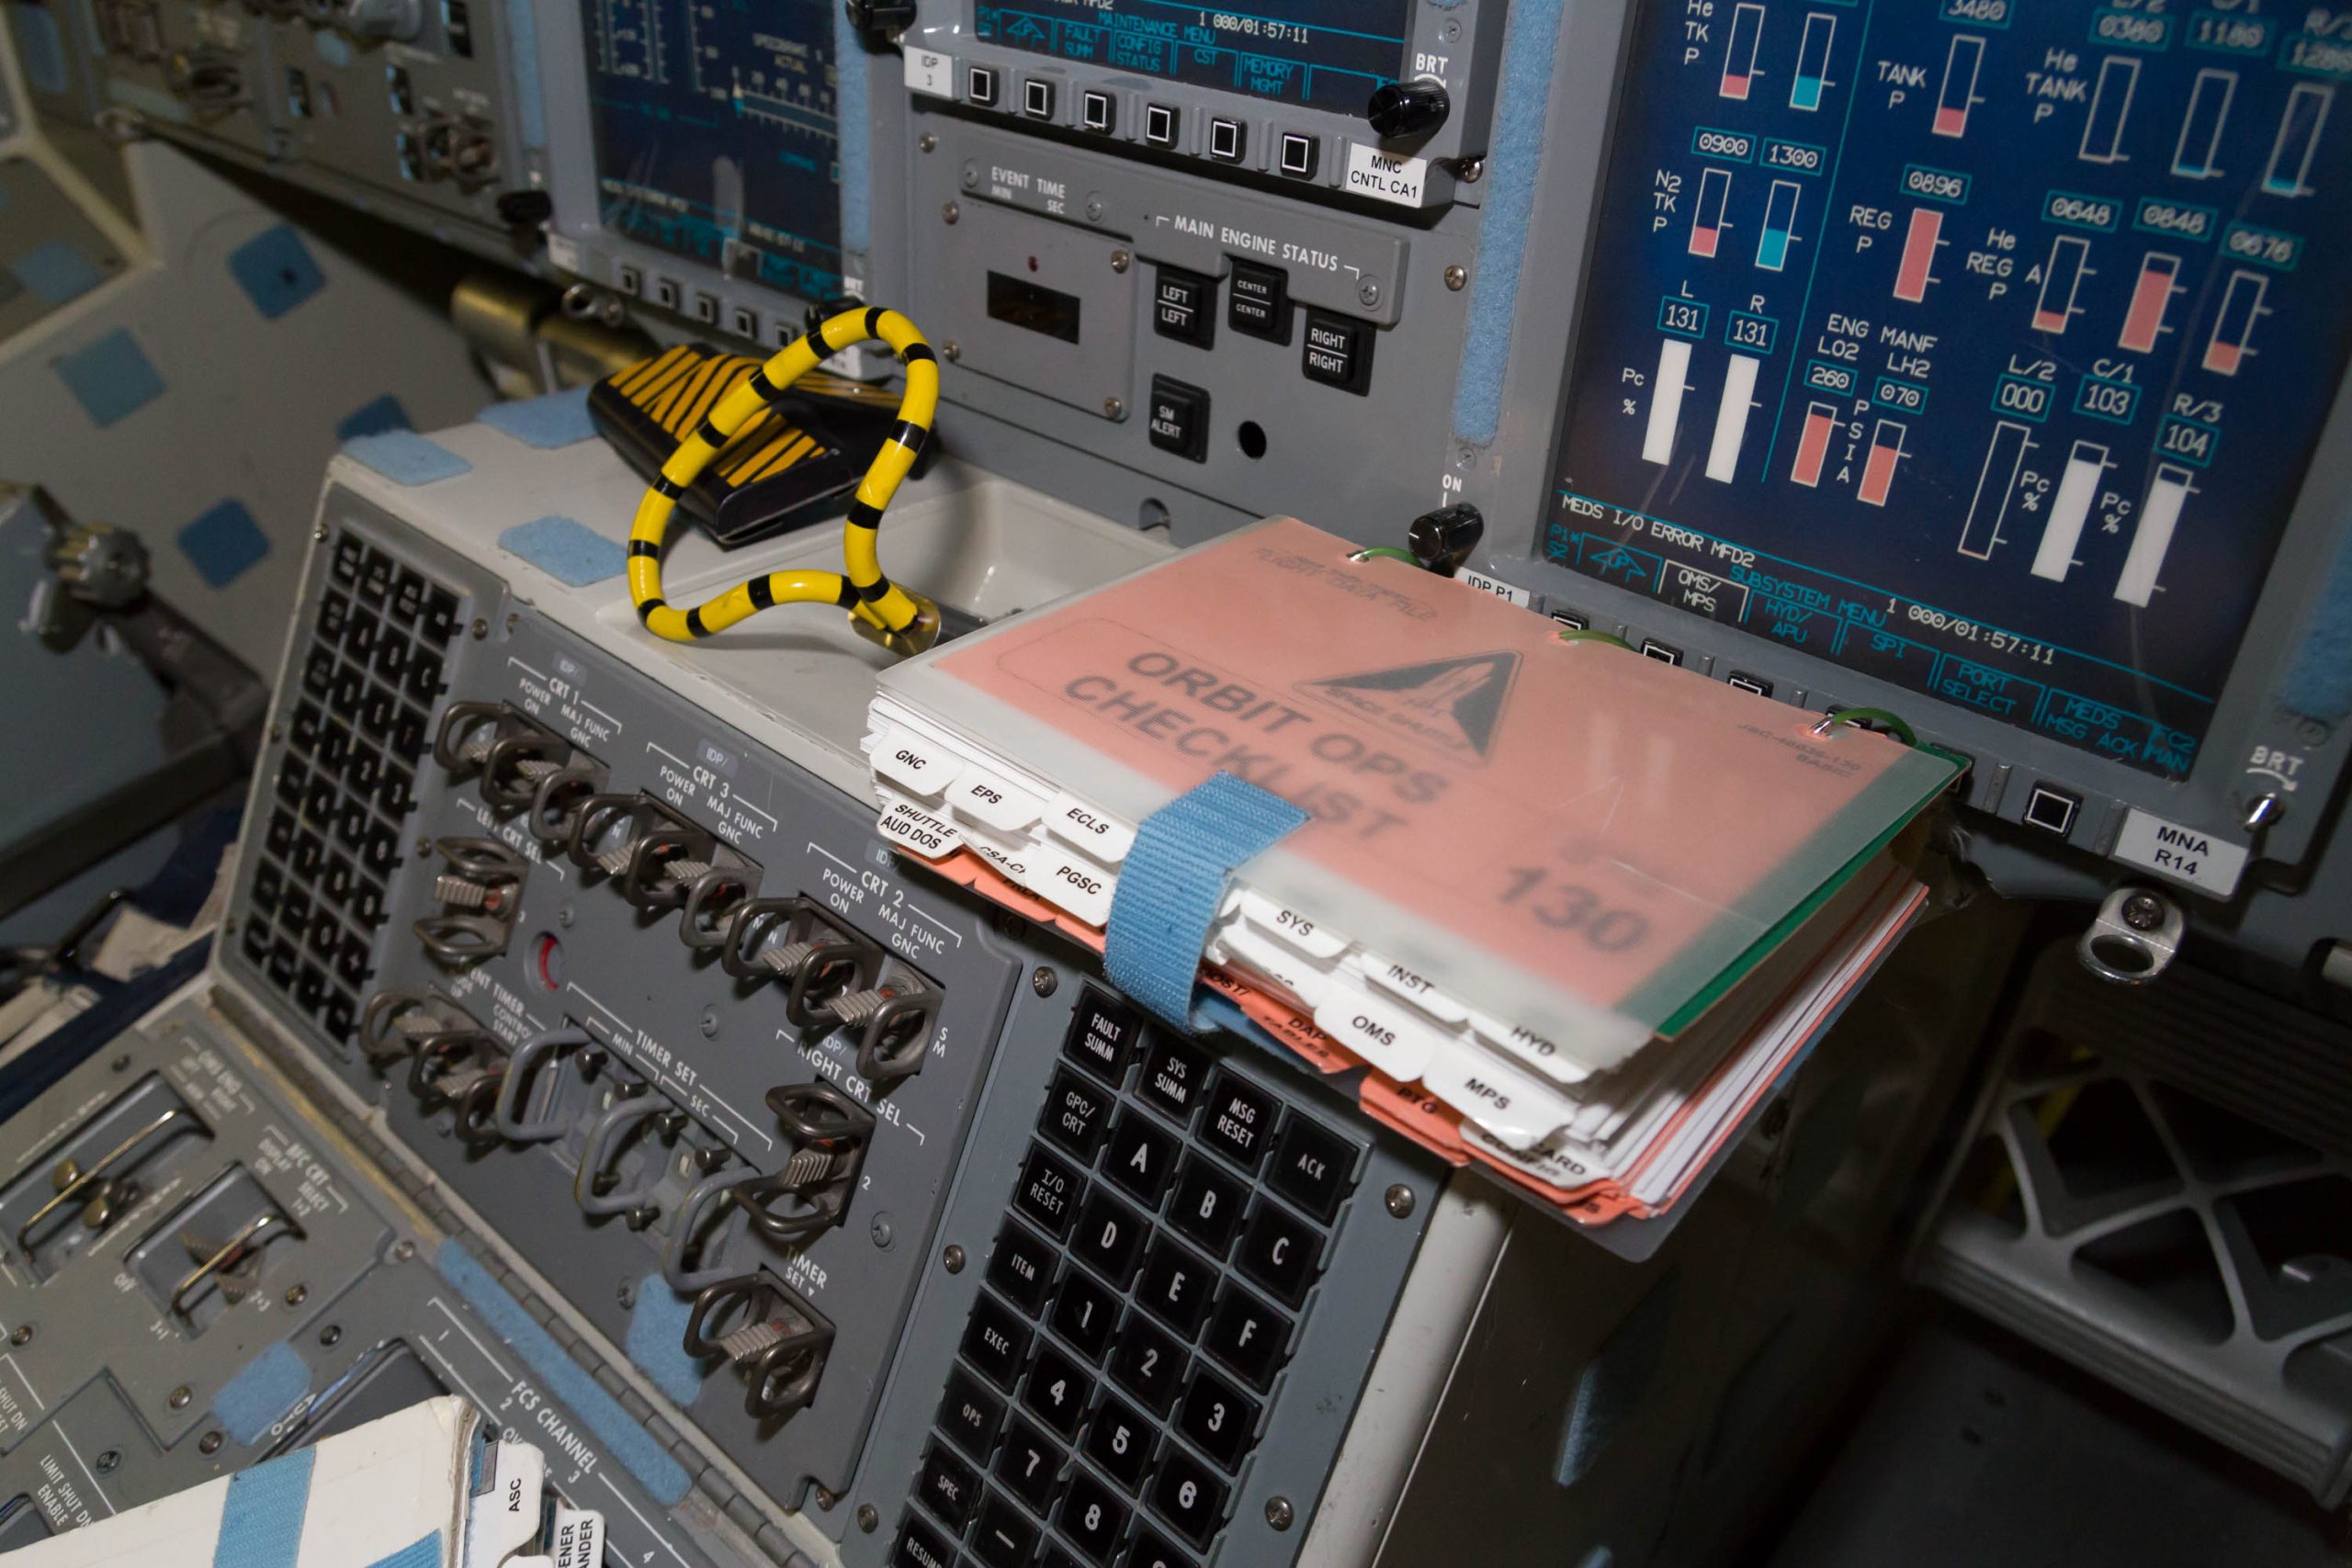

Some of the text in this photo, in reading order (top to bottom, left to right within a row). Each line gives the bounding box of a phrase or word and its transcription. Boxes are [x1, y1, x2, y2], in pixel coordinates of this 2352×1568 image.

[1117, 35, 1161, 55] CONFIG
[1685, 21, 1709, 43] TK
[1116, 52, 1161, 73] STATUS
[1244, 57, 1294, 77] MEMORY
[1416, 52, 1448, 74] BRT
[1877, 61, 1927, 88] TANK
[2026, 73, 2087, 103] TANK
[1699, 132, 1748, 156] 0900
[1769, 144, 1818, 168] 1300
[1371, 154, 1402, 174] MNC
[991, 165, 1066, 199] EVENT TIME
[1351, 171, 1418, 199] CNTL CA1
[1656, 169, 1681, 194] N2
[1654, 192, 1677, 213] TK
[1849, 204, 1893, 231] REG
[1174, 215, 1338, 271] MAIN ENGINE STATUS
[1966, 252, 2041, 285] REG A
[1162, 284, 1188, 304] LEFT
[1237, 279, 1267, 295] CENTER
[1161, 308, 1187, 326] LEFT
[1236, 303, 1266, 319] CENTER
[1666, 304, 1699, 332] 131
[1311, 327, 1345, 349] RIGHT
[1733, 320, 1767, 347] 131
[1827, 313, 1938, 354] ENG MANF
[1309, 351, 1344, 373] RIGHT
[2008, 354, 2057, 382] L/2
[2093, 358, 2135, 384] C/1
[2084, 384, 2131, 415] 103
[1150, 418, 1182, 439] ALERT
[2164, 424, 2209, 457] 104
[1442, 474, 1462, 493] ON
[1562, 494, 1756, 569] MEDS I/O ERROR MFD2
[1678, 569, 1722, 594] OMS/
[1683, 591, 1717, 613] MPS
[1730, 565, 2054, 666] SUBSYSTEM MENU 1 000/01:57:11
[1764, 599, 1812, 624] HYD/
[1770, 620, 1808, 643] APU
[1871, 634, 1907, 659] SPI
[548, 678, 581, 706] CRT 1
[1958, 663, 2013, 694] PORT
[519, 678, 609, 743] POWER MAJ FUNC
[524, 699, 540, 716] ON
[1941, 678, 2018, 716] SELECT
[1126, 650, 1449, 805] ORBIT OPS
[2064, 698, 2122, 730] MEDS
[570, 727, 592, 749] GNC
[2046, 712, 2143, 759] MSG ACK
[895, 749, 927, 771] GNC
[2250, 746, 2304, 776] BRT
[692, 766, 729, 799] CRT 3
[970, 784, 1002, 806] EPS
[660, 765, 763, 840] POWER MAJ FUNC
[666, 787, 684, 807] ON
[718, 821, 742, 844] GNC
[880, 815, 943, 850] AUD DOS
[894, 804, 958, 839] SHUTTLE
[1066, 807, 1110, 836] ECLS
[502, 828, 523, 849] CRT
[2156, 826, 2210, 857] MNA
[2154, 849, 2199, 875] R14
[861, 870, 904, 908] CRT 2
[1056, 865, 1102, 896] PGSC
[822, 868, 945, 954] POWER MAJ FUNC
[830, 892, 850, 914] ON
[1494, 865, 1651, 953] 130
[1276, 909, 1314, 937] SYS
[891, 933, 921, 959] GNC
[1386, 964, 1435, 994] INST
[1091, 1012, 1122, 1041] FAULT
[1288, 1017, 1328, 1043] DAP
[1351, 1015, 1396, 1046] OMS
[1510, 1025, 1556, 1056] HYD
[636, 1029, 697, 1088] TIMER SET
[1084, 1032, 1114, 1063] SUMM
[612, 1032, 710, 1118] MIN SEC
[1168, 1056, 1187, 1079] SYS
[797, 1043, 901, 1126] RIGHT CRT SEL
[1155, 1074, 1187, 1103] SUMM
[1464, 1077, 1511, 1111] MPS
[1066, 1091, 1096, 1119] GPC/
[1228, 1098, 1256, 1123] MSG
[1062, 1111, 1086, 1136] CRT
[1217, 1116, 1254, 1148] RESET
[1130, 1143, 1148, 1174] A
[1297, 1154, 1326, 1180] ACK
[1030, 1182, 1064, 1215] RESET
[1198, 1190, 1216, 1219] B
[1101, 1221, 1117, 1248] D
[1272, 1236, 1289, 1265] C
[1012, 1254, 1035, 1282] ITEM
[1168, 1271, 1185, 1302] E
[984, 1326, 1010, 1356] EXEC
[1238, 1319, 1257, 1348] F
[1140, 1348, 1159, 1378] 2
[499, 1396, 513, 1411] 2
[1049, 1380, 1067, 1405] 4
[11, 1411, 28, 1431] DN
[512, 1381, 599, 1474] FCS CHANNEL
[962, 1404, 982, 1427] OPS
[1207, 1403, 1226, 1432] 3
[1112, 1425, 1131, 1455] 5
[568, 1471, 581, 1483] 3
[1025, 1449, 1041, 1478] 7
[40, 1454, 64, 1485] LIMIT
[58, 1483, 83, 1513] SHUT
[508, 1477, 522, 1513] ASC
[937, 1474, 961, 1502] SPEC
[1178, 1480, 1197, 1509] 6
[38, 1483, 69, 1528] ENABLE
[1084, 1504, 1102, 1531] 8
[643, 1551, 655, 1563] 4
